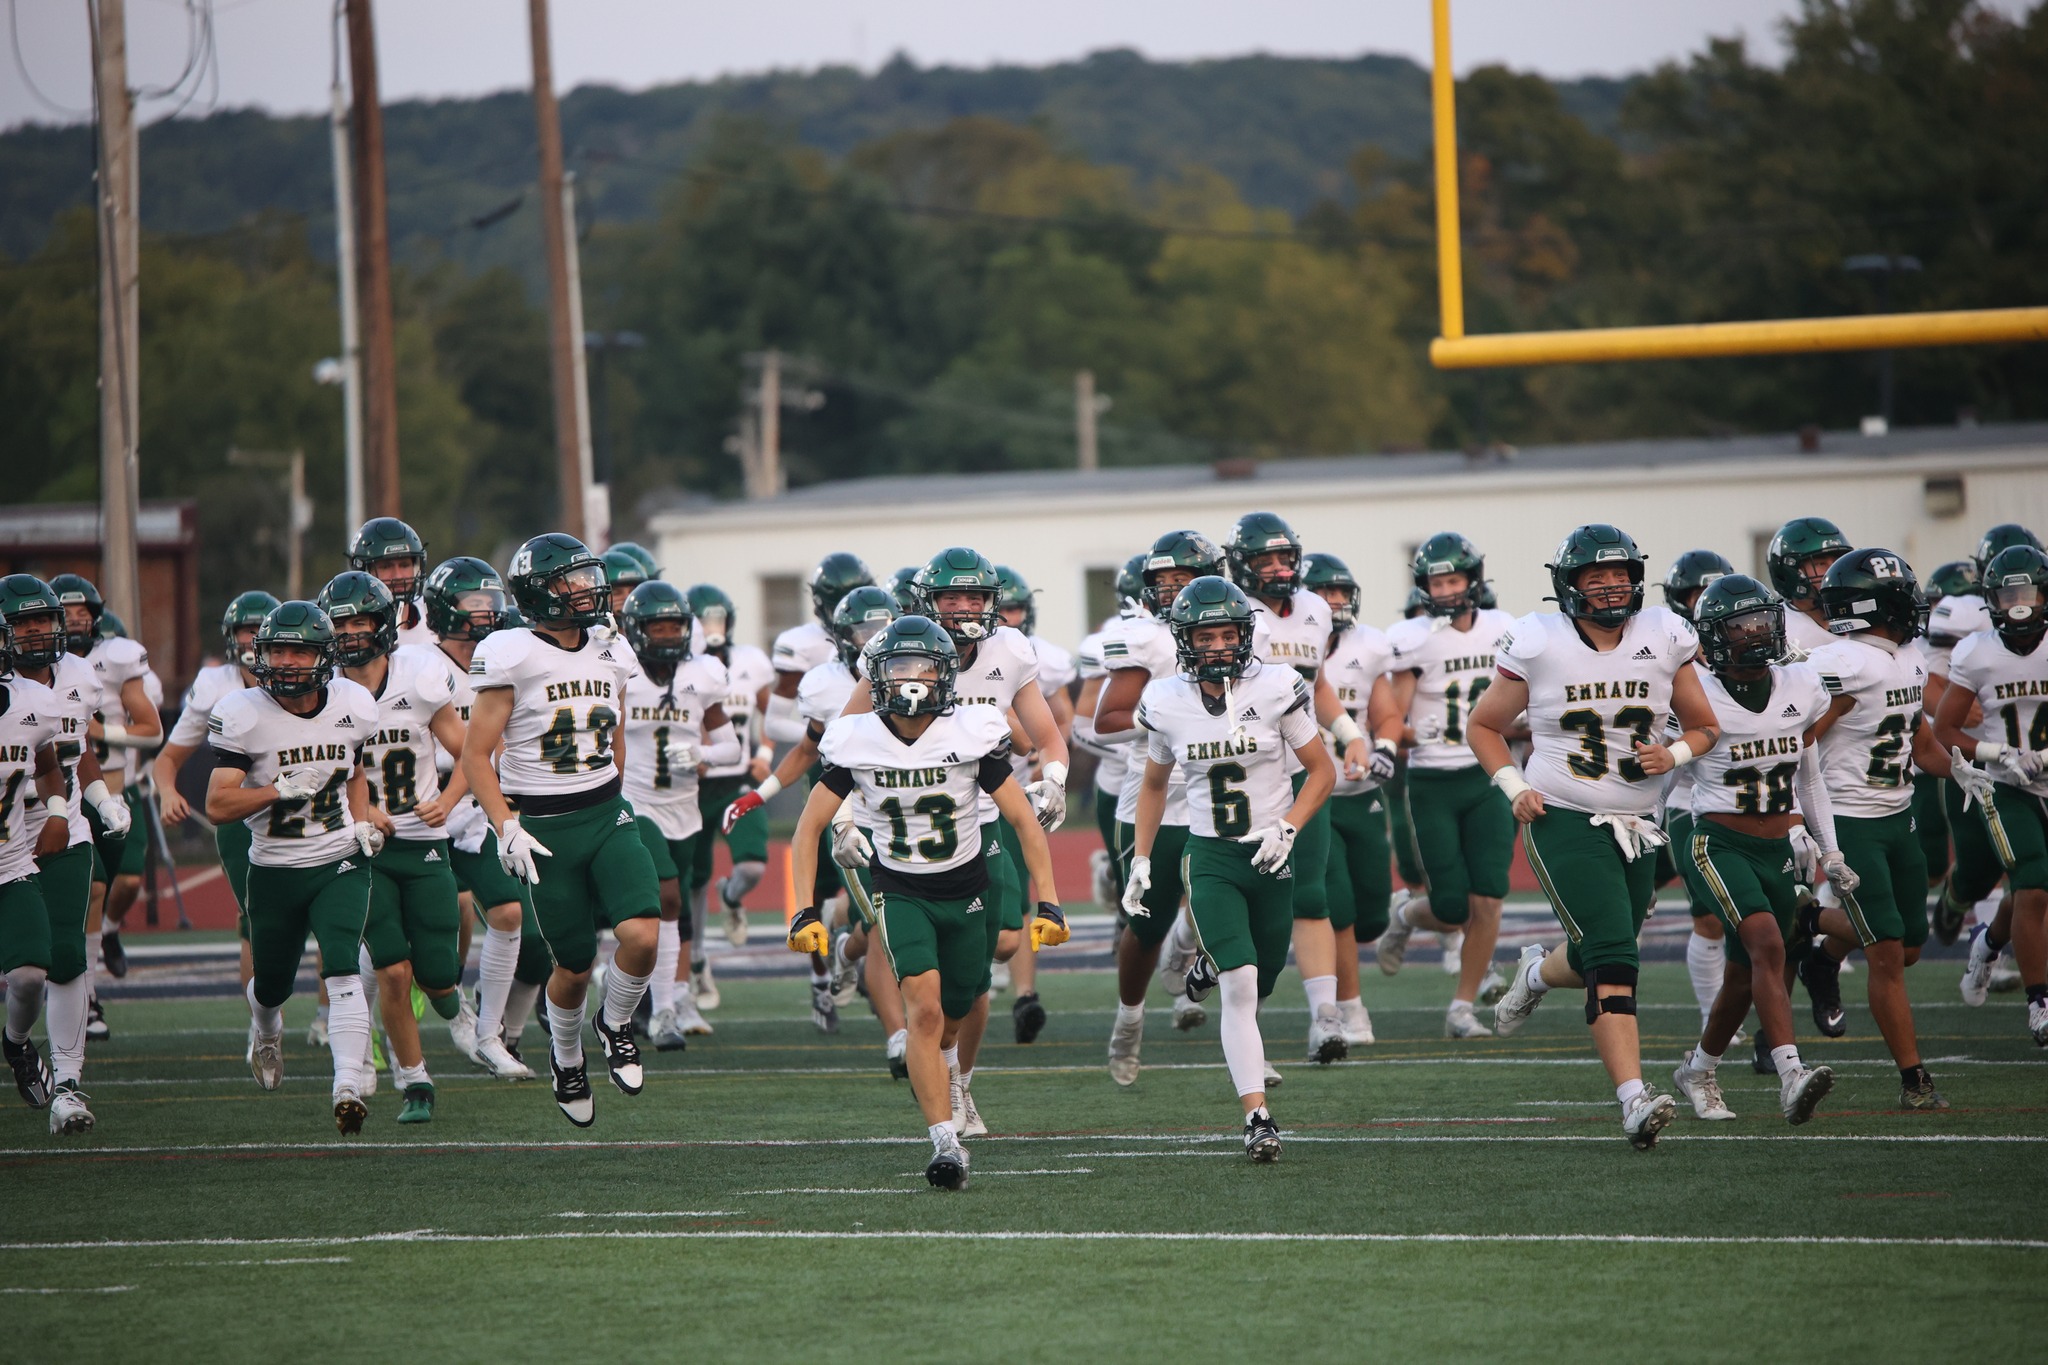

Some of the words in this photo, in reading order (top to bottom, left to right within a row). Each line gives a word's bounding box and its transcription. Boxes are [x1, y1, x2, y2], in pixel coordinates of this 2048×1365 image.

[1869, 556, 1904, 579] 27
[598, 655, 617, 663] adidas
[1270, 642, 1318, 660] MMAUS
[1445, 655, 1496, 674] EMMAUS
[67, 695, 81, 703] adidas
[546, 680, 611, 703] EMMAUS
[1564, 681, 1650, 703] EMMAUS
[1885, 685, 1922, 708] EMMAUS
[1994, 679, 2048, 700] EMMAU
[632, 706, 690, 722] EMMAUS
[540, 704, 620, 775] 43
[1187, 737, 1258, 761] EMMAUS
[1559, 705, 1656, 783] 33
[1729, 736, 1799, 762] EMMAUS
[277, 744, 346, 767] EMMAUS
[653, 725, 673, 790] 1
[873, 767, 947, 788] EMMAUS
[267, 767, 350, 838] 24
[1207, 761, 1252, 838] 6
[616, 817, 634, 827] adidas
[880, 792, 958, 862] 13
[966, 905, 984, 914] adidas
